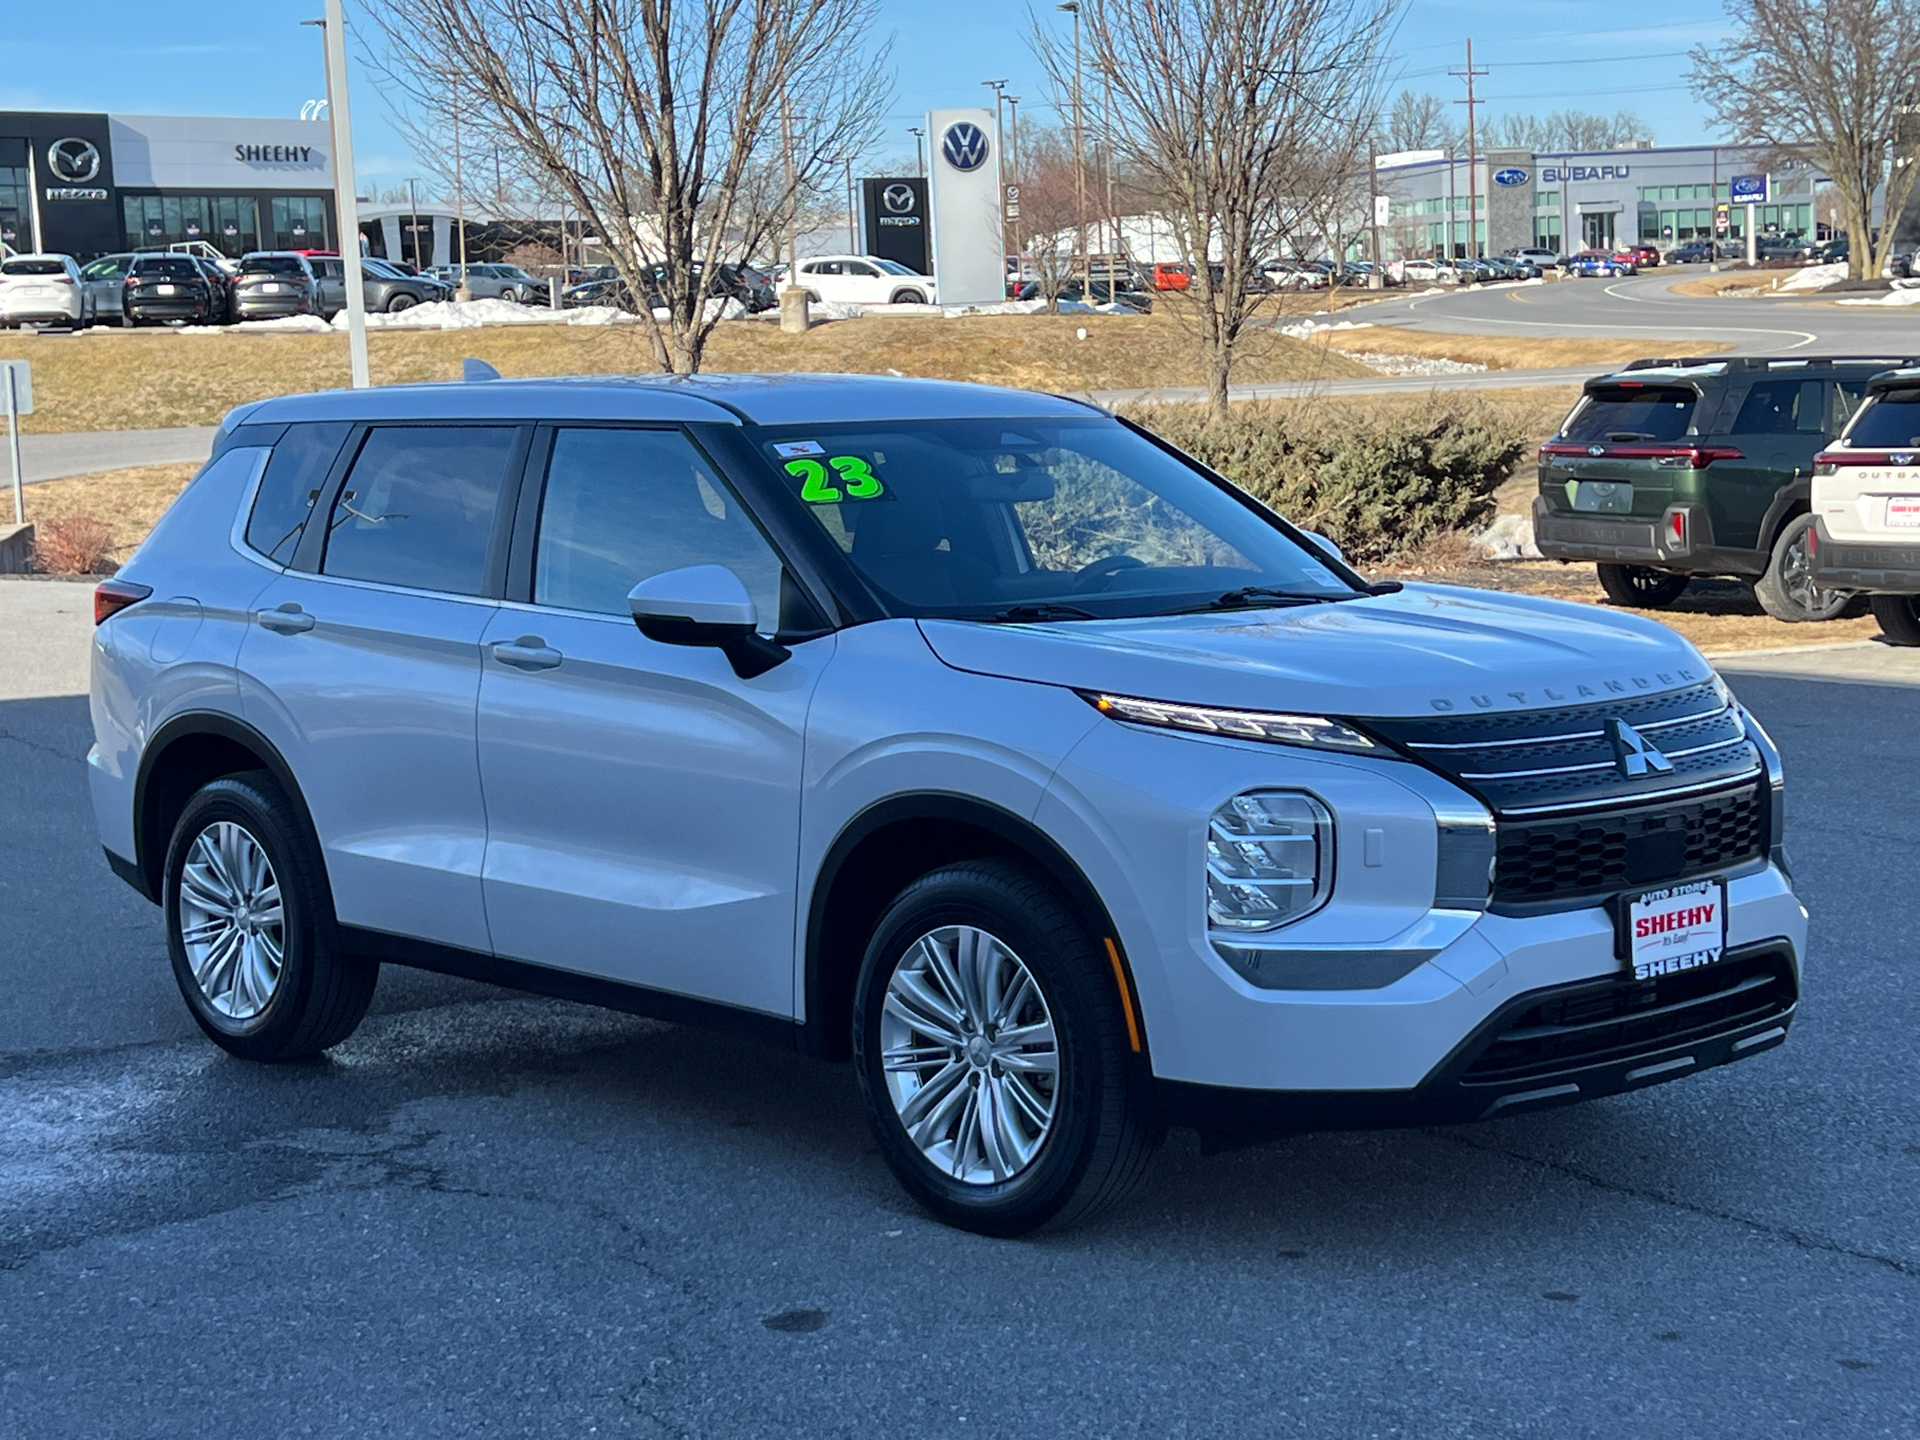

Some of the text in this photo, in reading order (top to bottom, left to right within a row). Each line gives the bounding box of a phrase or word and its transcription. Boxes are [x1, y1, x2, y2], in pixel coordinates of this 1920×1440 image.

[235, 144, 311, 162] SHEEHY
[1542, 165, 1630, 182] SUBARU
[1733, 193, 1764, 203] SUBARU
[784, 455, 884, 503] 23
[1430, 669, 1697, 711] OUTLANDER
[1640, 880, 1714, 904] AUTO STORES
[1635, 903, 1715, 938] SHEEHY
[1635, 946, 1722, 980] SHEEHY
